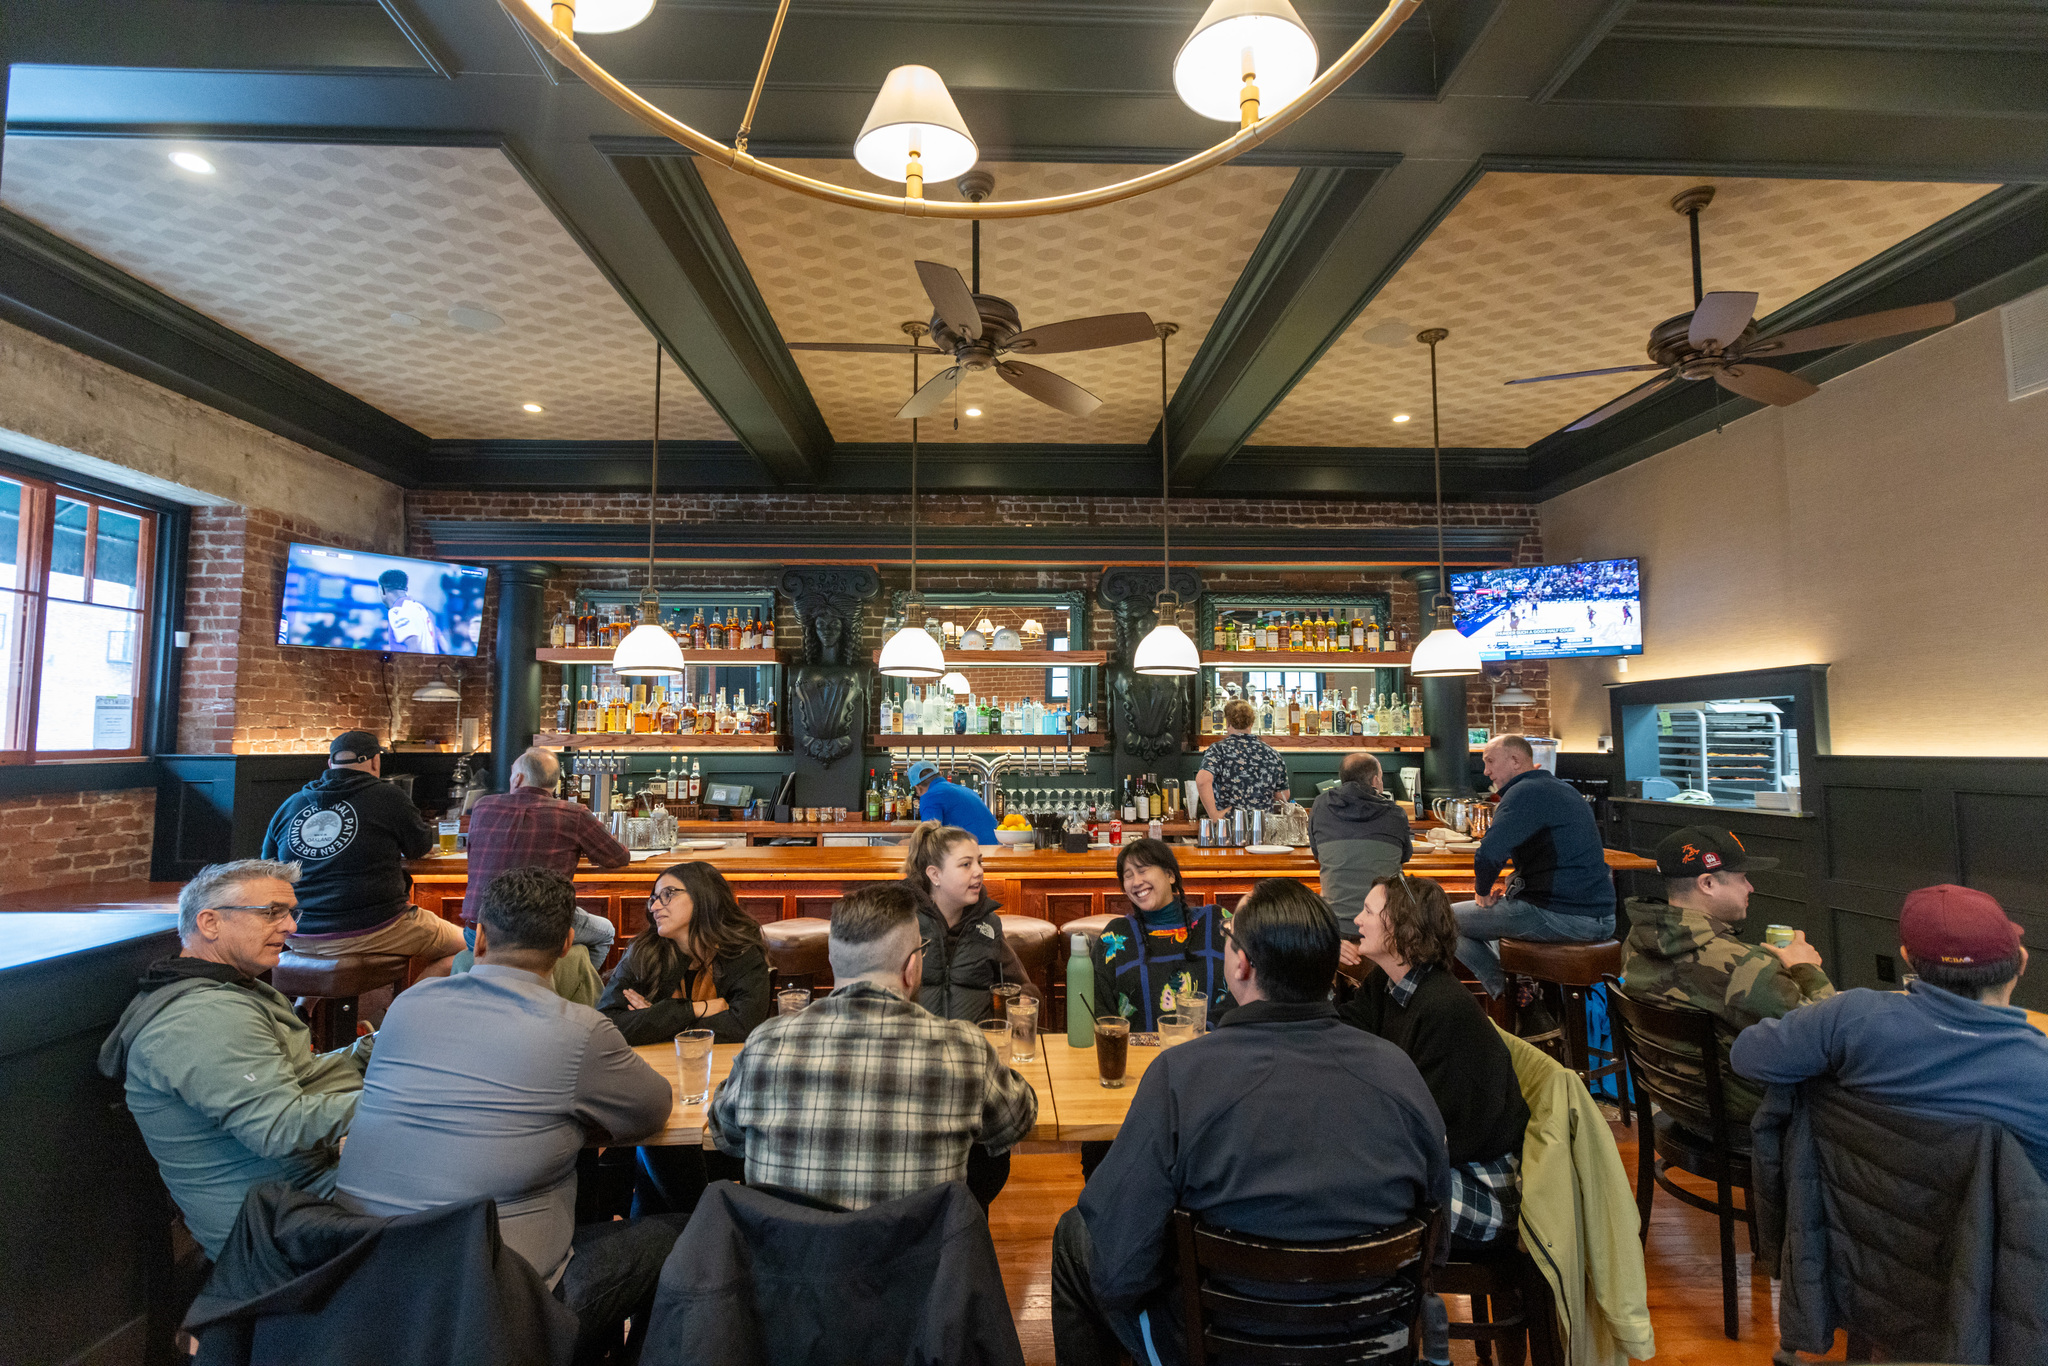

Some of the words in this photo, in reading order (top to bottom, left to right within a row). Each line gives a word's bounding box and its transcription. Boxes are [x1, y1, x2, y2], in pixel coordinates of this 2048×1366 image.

[302, 803, 349, 817] ORNAL
[291, 819, 317, 857] BREWING
[320, 818, 353, 856] PATTERN
